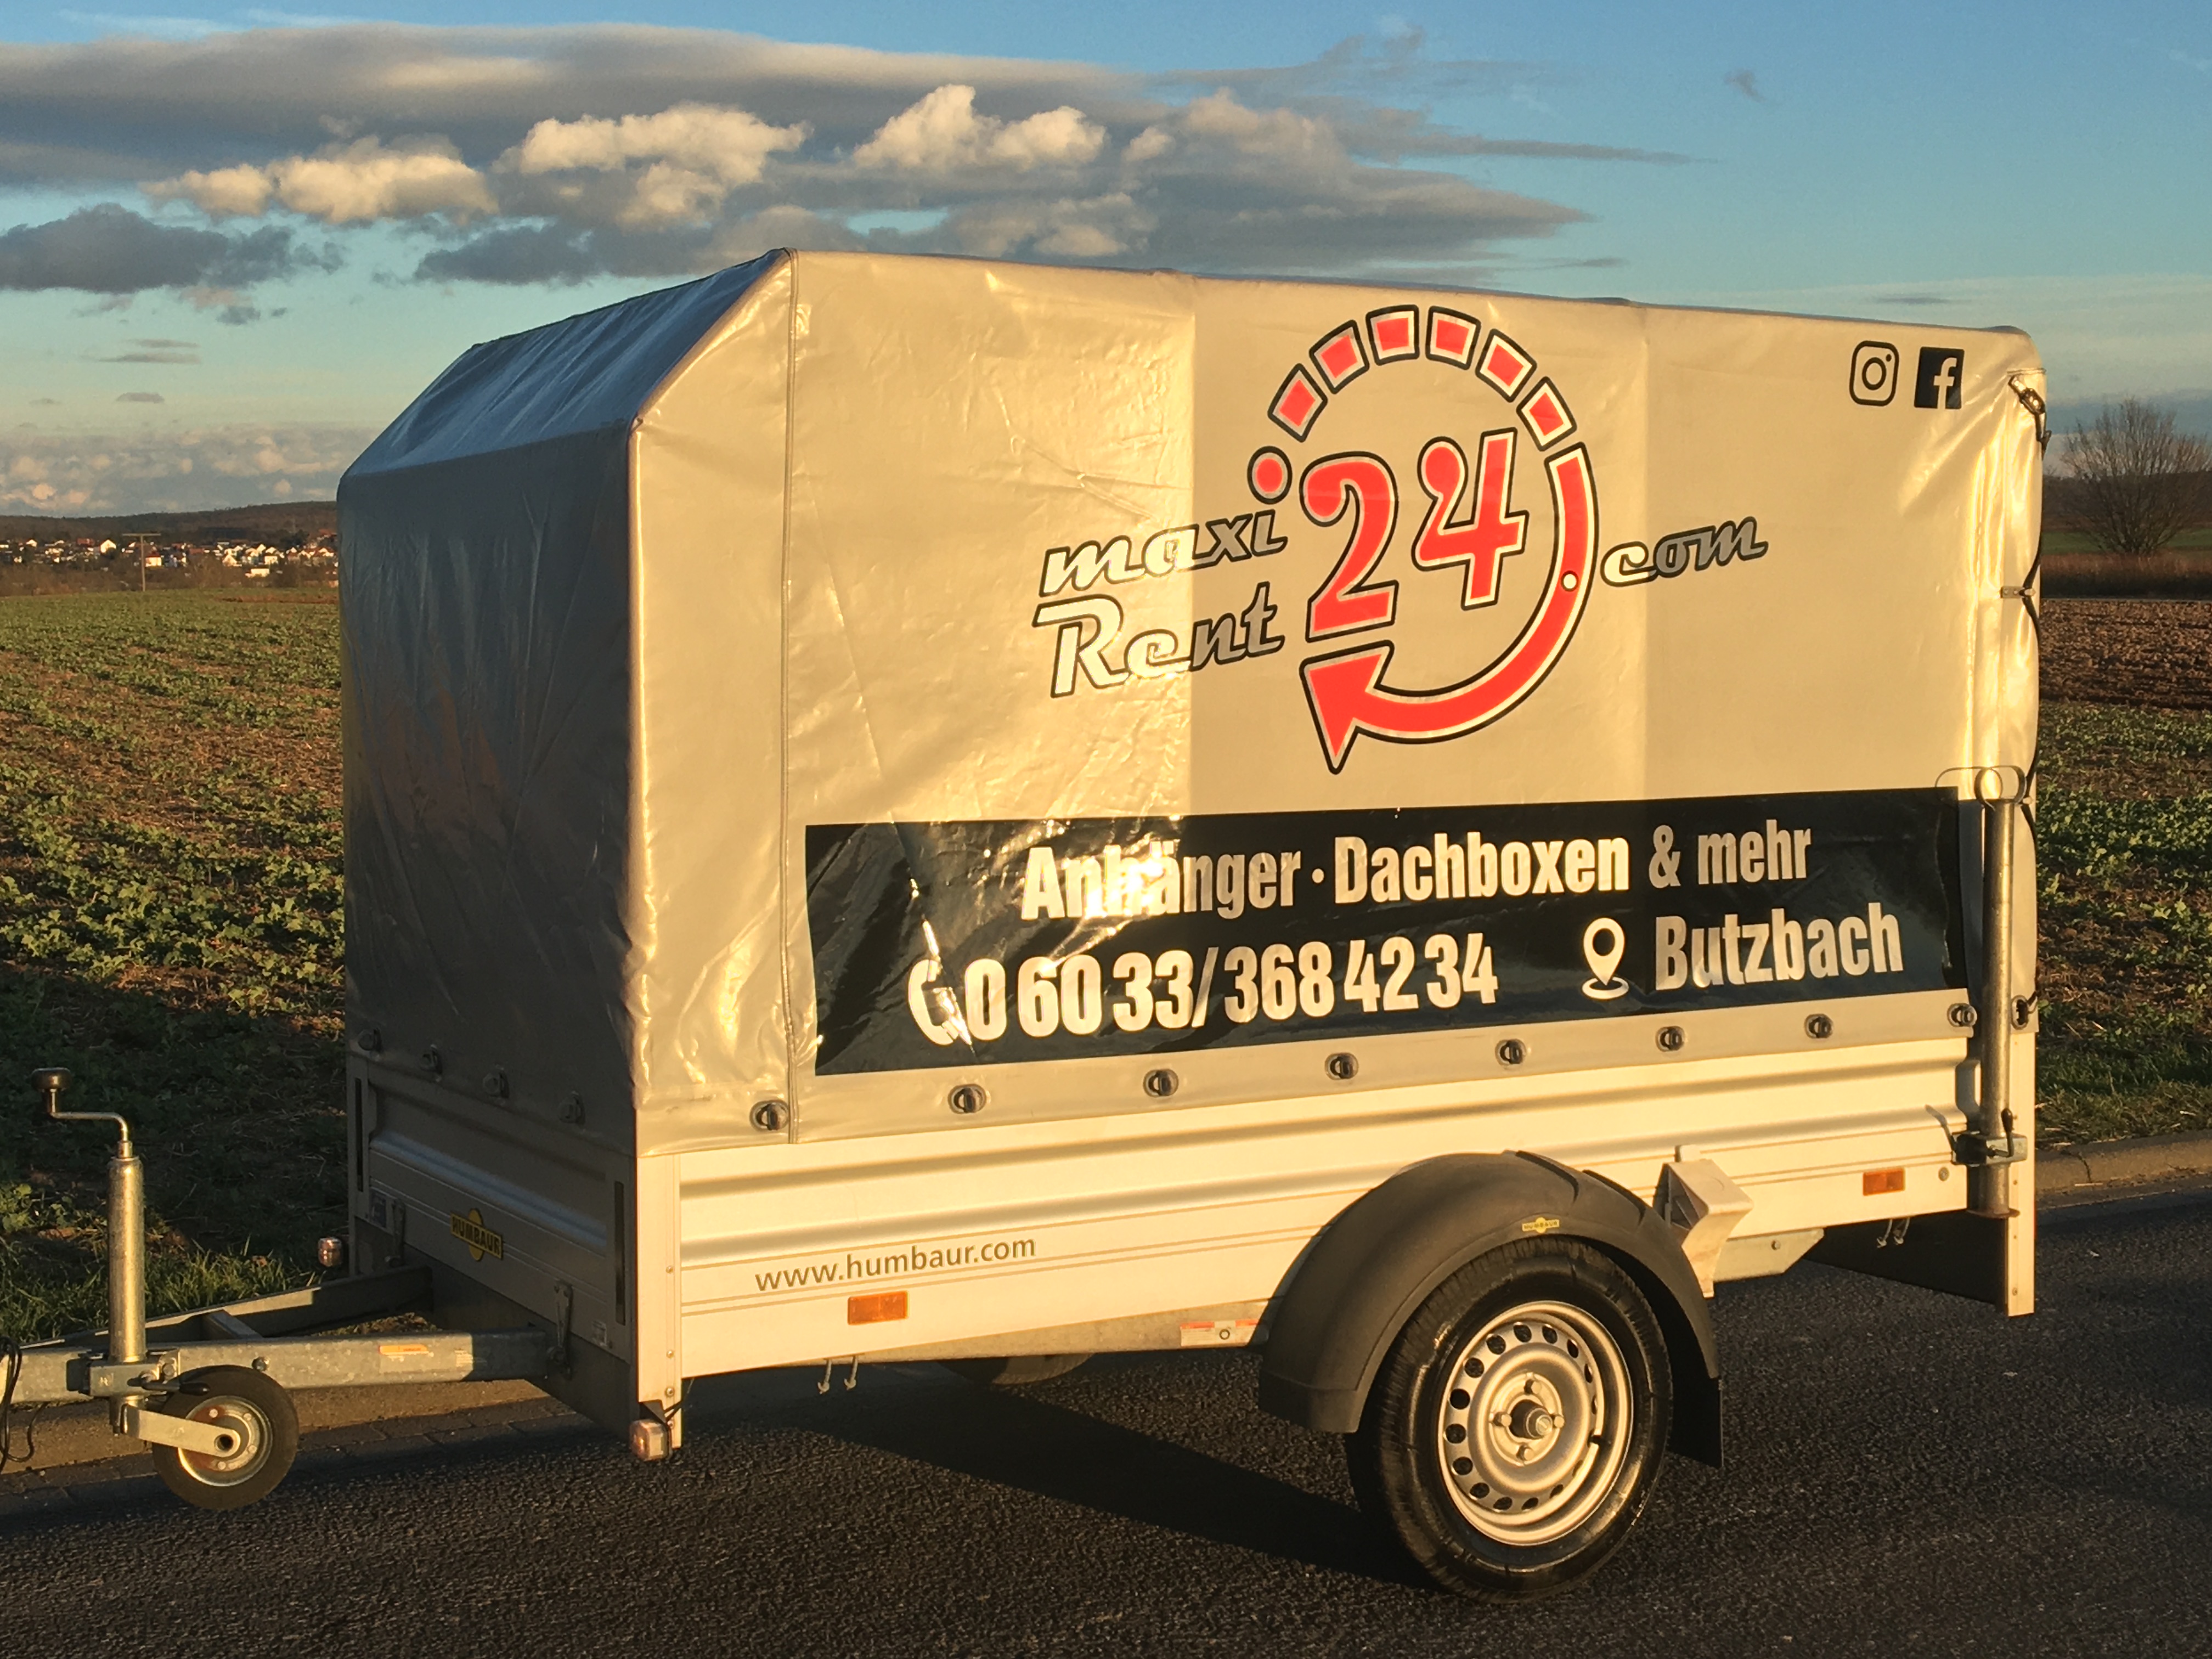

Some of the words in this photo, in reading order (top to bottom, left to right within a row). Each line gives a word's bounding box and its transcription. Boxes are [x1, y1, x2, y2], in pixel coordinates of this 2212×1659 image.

[1039, 446, 1288, 598] maxi
[1299, 427, 1529, 643] 24
[1033, 583, 1285, 698] Rent
[1021, 840, 1301, 919] Anhänger
[1334, 831, 1629, 905] Dachboxen
[1648, 824, 1681, 889] &
[1697, 819, 1813, 886] mehr
[1656, 902, 1904, 991] Butzbach
[451, 1215, 501, 1256] HUMBAUR
[754, 1238, 1037, 1291] www.humbaur.com
